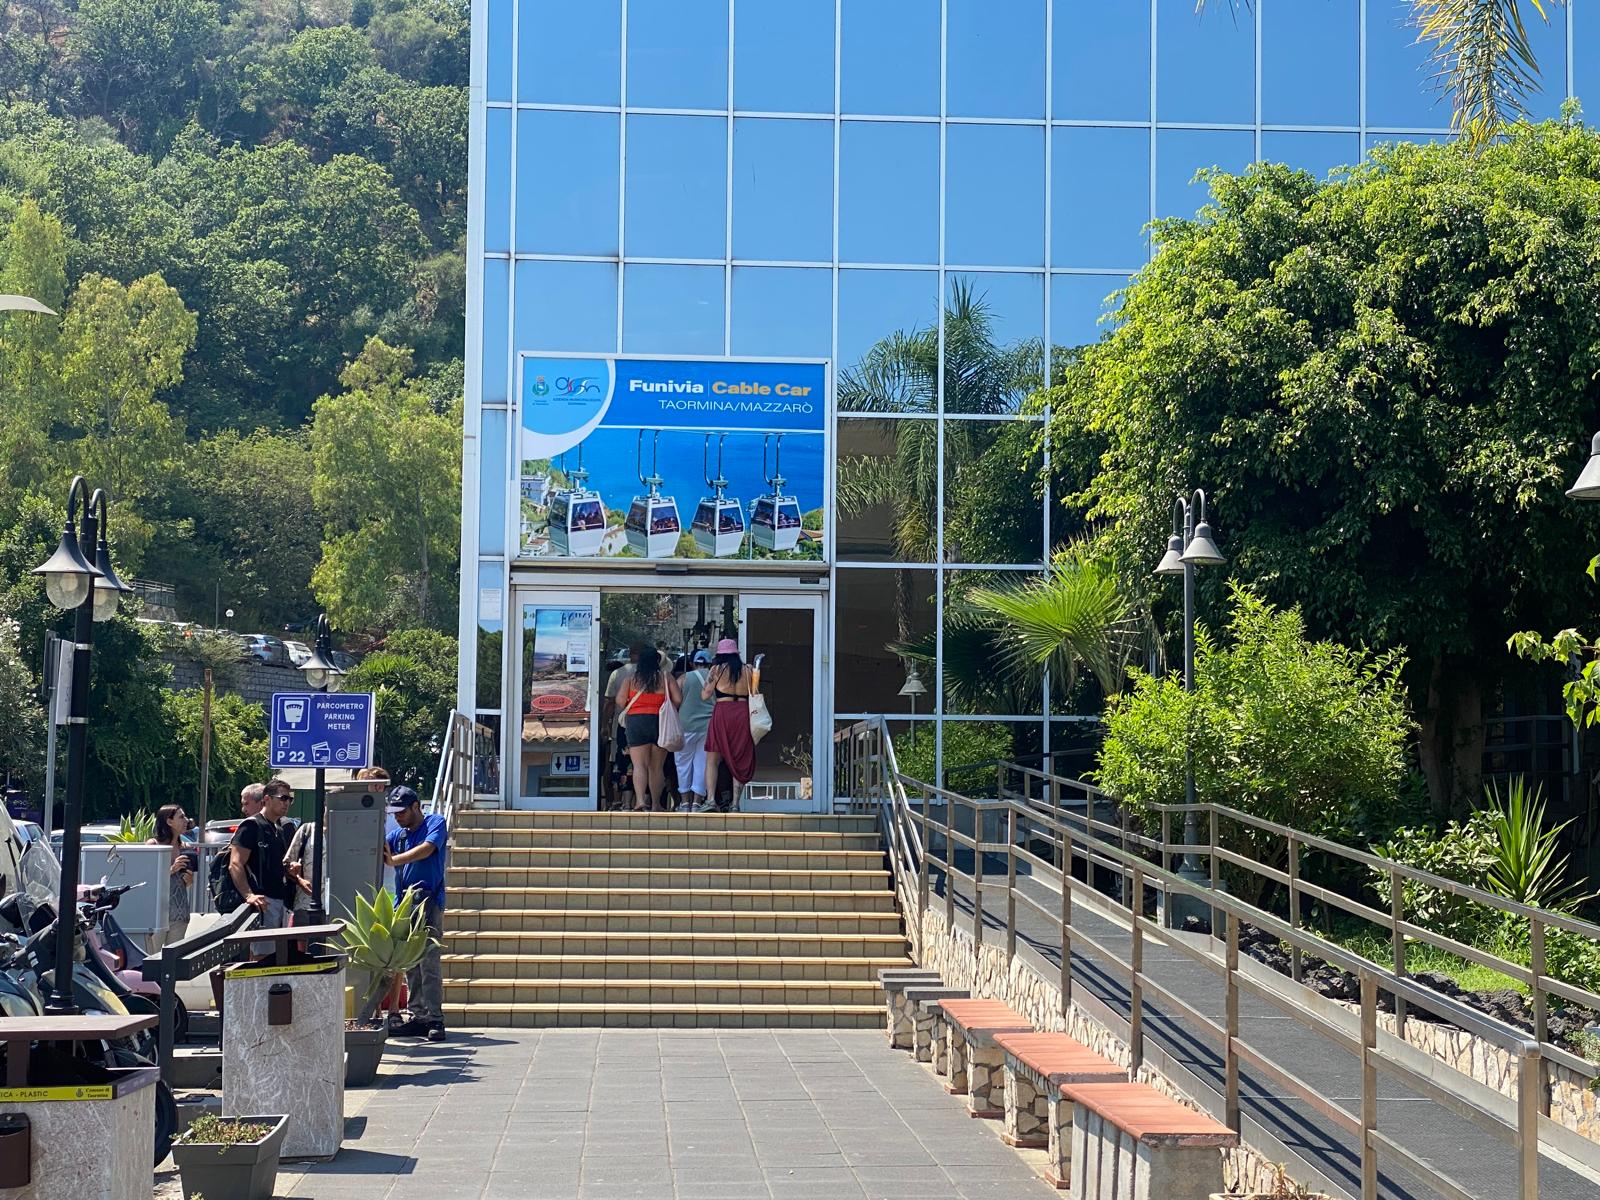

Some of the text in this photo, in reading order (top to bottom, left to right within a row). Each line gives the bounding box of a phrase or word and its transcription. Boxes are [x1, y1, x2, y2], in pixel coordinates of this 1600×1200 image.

[629, 379, 812, 397] Funivia Cable Car
[658, 399, 813, 414] TAORMINA/MAZZARÒ
[316, 702, 364, 710] PARCOMETRO
[280, 737, 287, 747] P
[277, 751, 305, 762] P 22
[20, 1090, 48, 1098] PLASTIC
